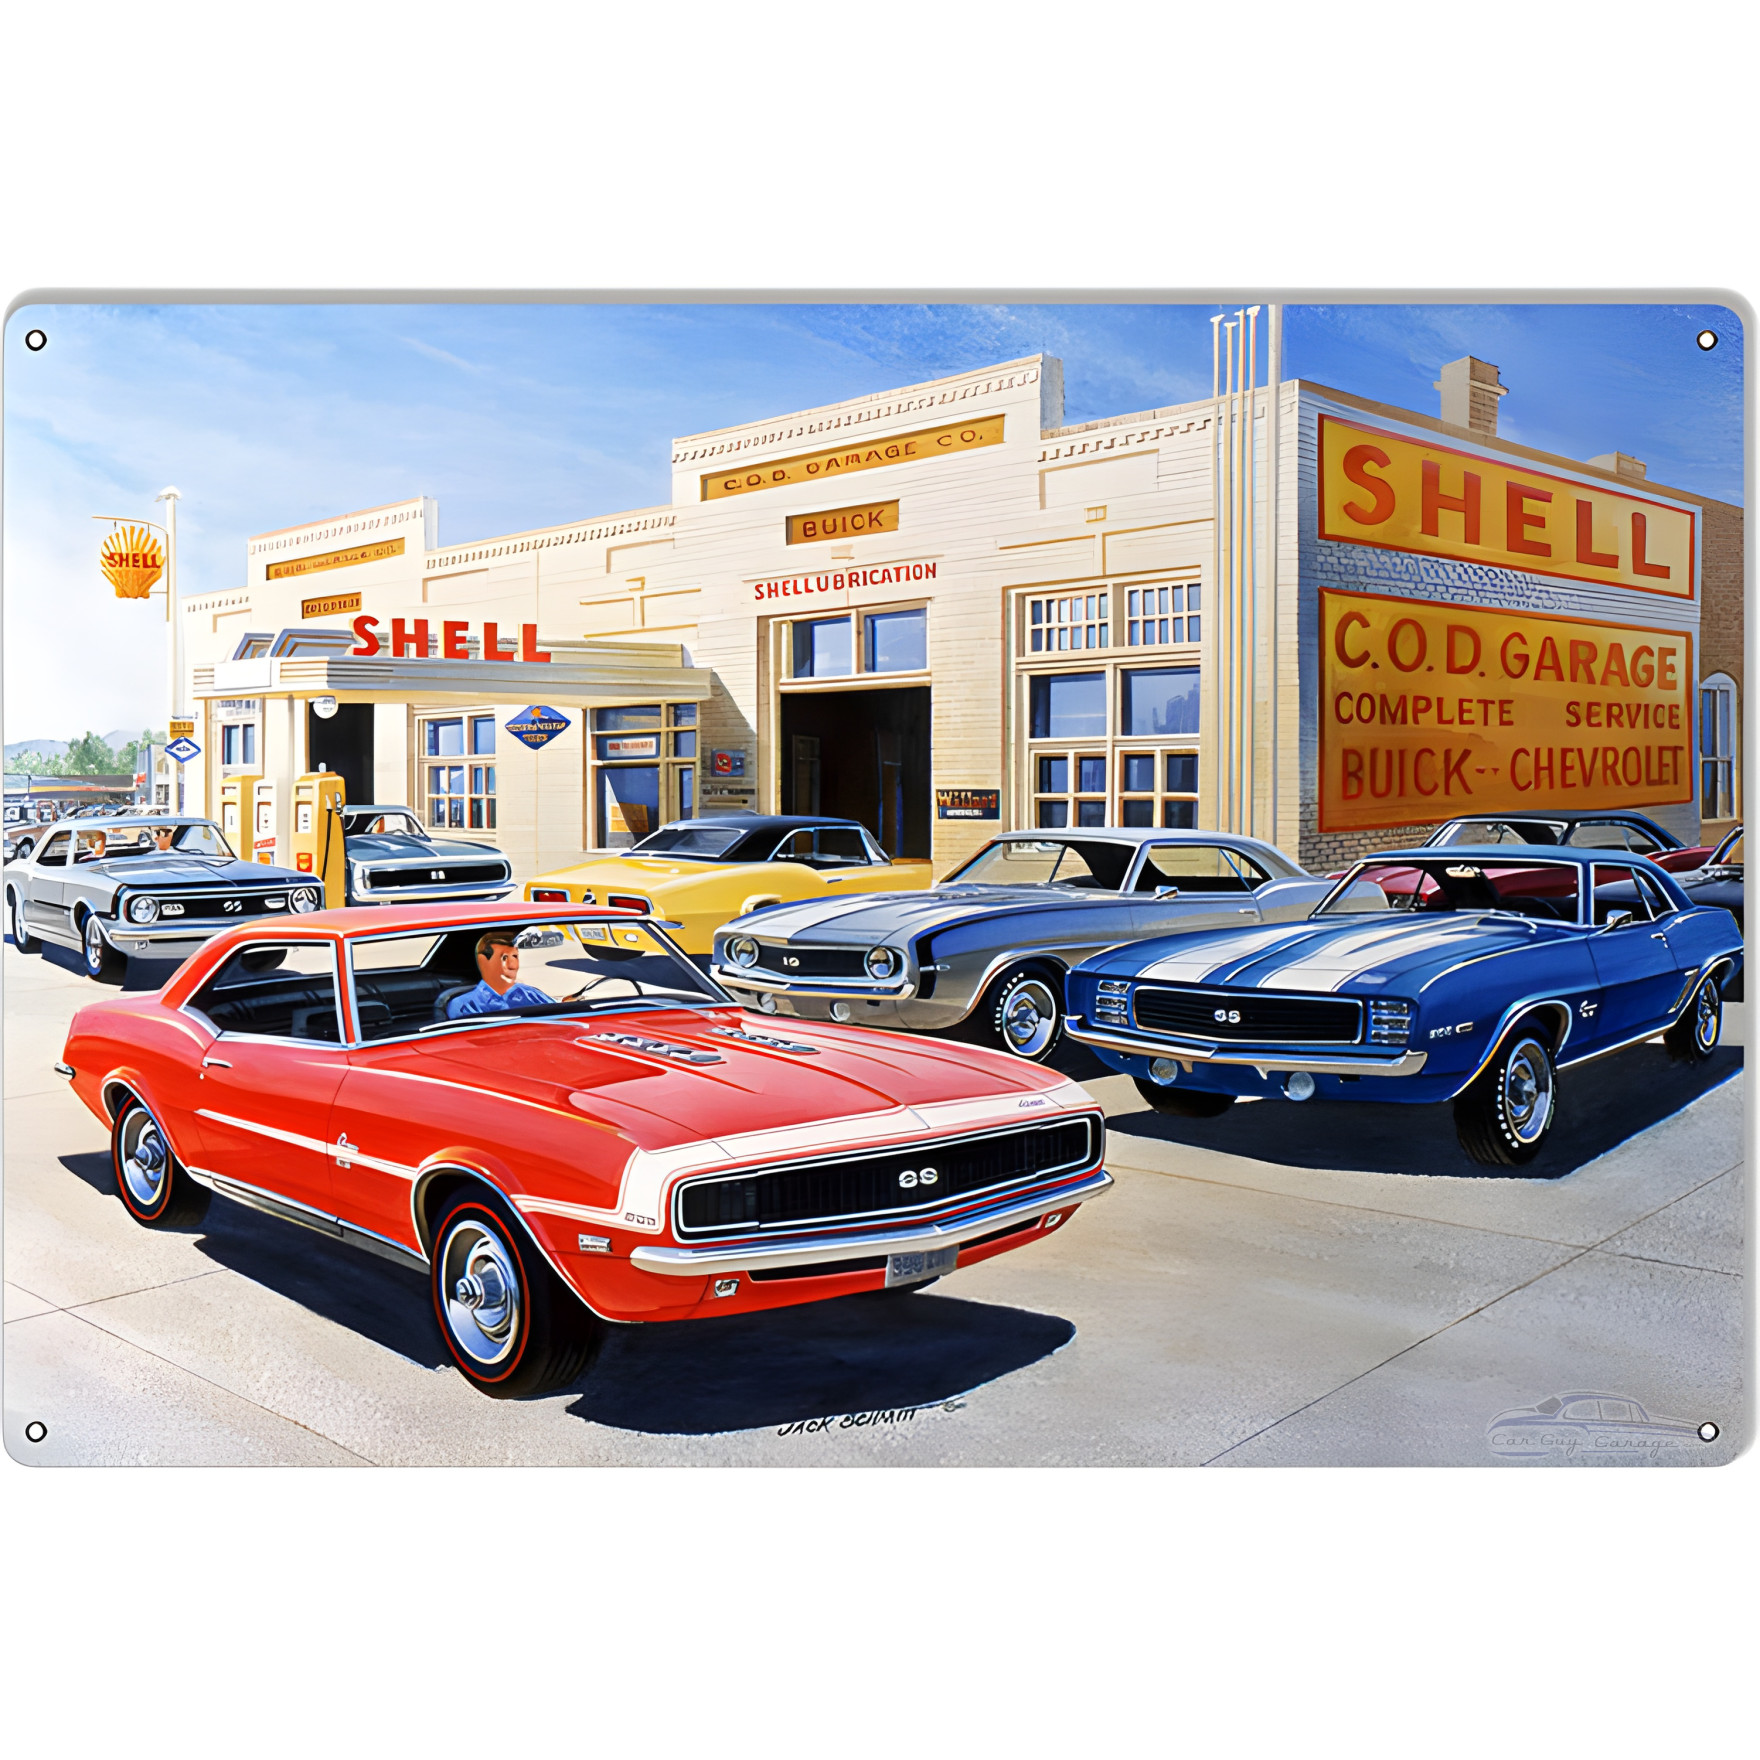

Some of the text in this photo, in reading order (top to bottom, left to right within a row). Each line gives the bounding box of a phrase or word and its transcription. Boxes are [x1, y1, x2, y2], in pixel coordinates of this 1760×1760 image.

[936, 429, 983, 448] CO.
[802, 508, 885, 538] BUICK
[1342, 444, 1671, 580] SHELL
[107, 552, 161, 568] SHELL
[754, 562, 938, 600] SHELLUBRICATION
[352, 615, 552, 663] SHELL
[1334, 611, 1678, 691] C.O.D. GARAGE
[1334, 691, 1681, 730] COMPLETE SERVICE
[1509, 745, 1685, 792] CHEVROLET
